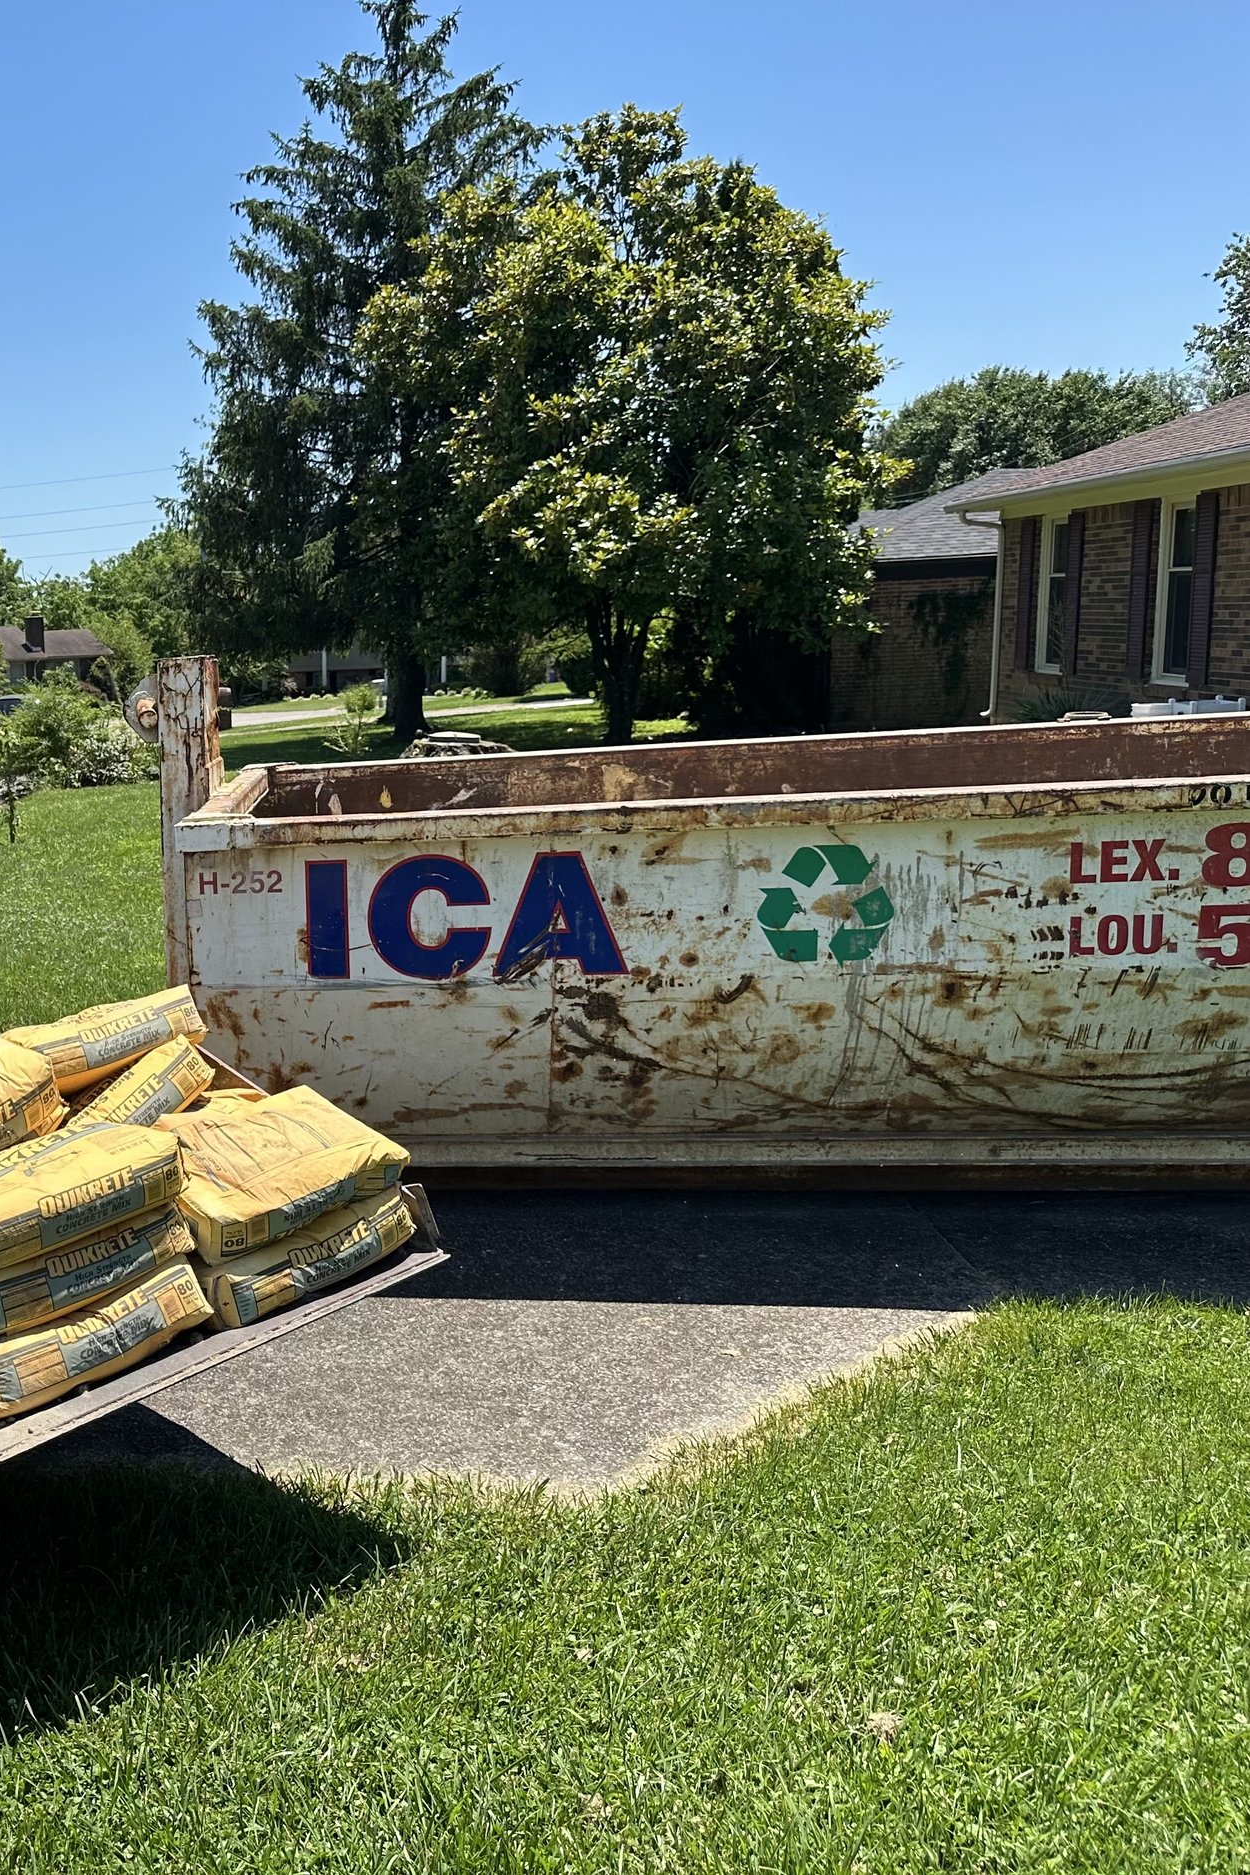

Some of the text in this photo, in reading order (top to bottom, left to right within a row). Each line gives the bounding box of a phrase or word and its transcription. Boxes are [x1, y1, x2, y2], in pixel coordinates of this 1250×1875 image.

[1069, 839, 1180, 884] LEX.
[198, 870, 284, 896] H-252
[304, 850, 630, 981] ICA
[1069, 914, 1178, 957] LOU.
[78, 1006, 160, 1044] QUIKRETE
[183, 1006, 196, 1018] 80
[97, 1029, 161, 1057] CONCRETE MIX
[103, 1025, 152, 1048] HIGH STRENGTH
[187, 1057, 200, 1072] 80
[110, 1069, 135, 1094] HIGH
[42, 1088, 56, 1103] 80
[106, 1074, 165, 1124] IKRETE
[153, 1098, 171, 1116] MIX
[133, 1097, 162, 1122] STRENGTH
[165, 1165, 180, 1181] 80
[37, 1165, 136, 1219] QUIKRETE
[56, 1197, 132, 1235] CONCRETE MIX
[65, 1197, 124, 1223] HIGH STRENGTH
[283, 1209, 303, 1222] MIX
[396, 1208, 408, 1227] 80
[45, 1227, 140, 1279] QUIKRETE
[224, 1237, 246, 1249] 80
[287, 1217, 371, 1269] QUIKRETE
[74, 1253, 132, 1282] HIGH STRENGTH
[305, 1249, 371, 1284] CONCRETE MIX
[177, 1280, 194, 1296] 80
[56, 1287, 148, 1344] QUIKRETE
